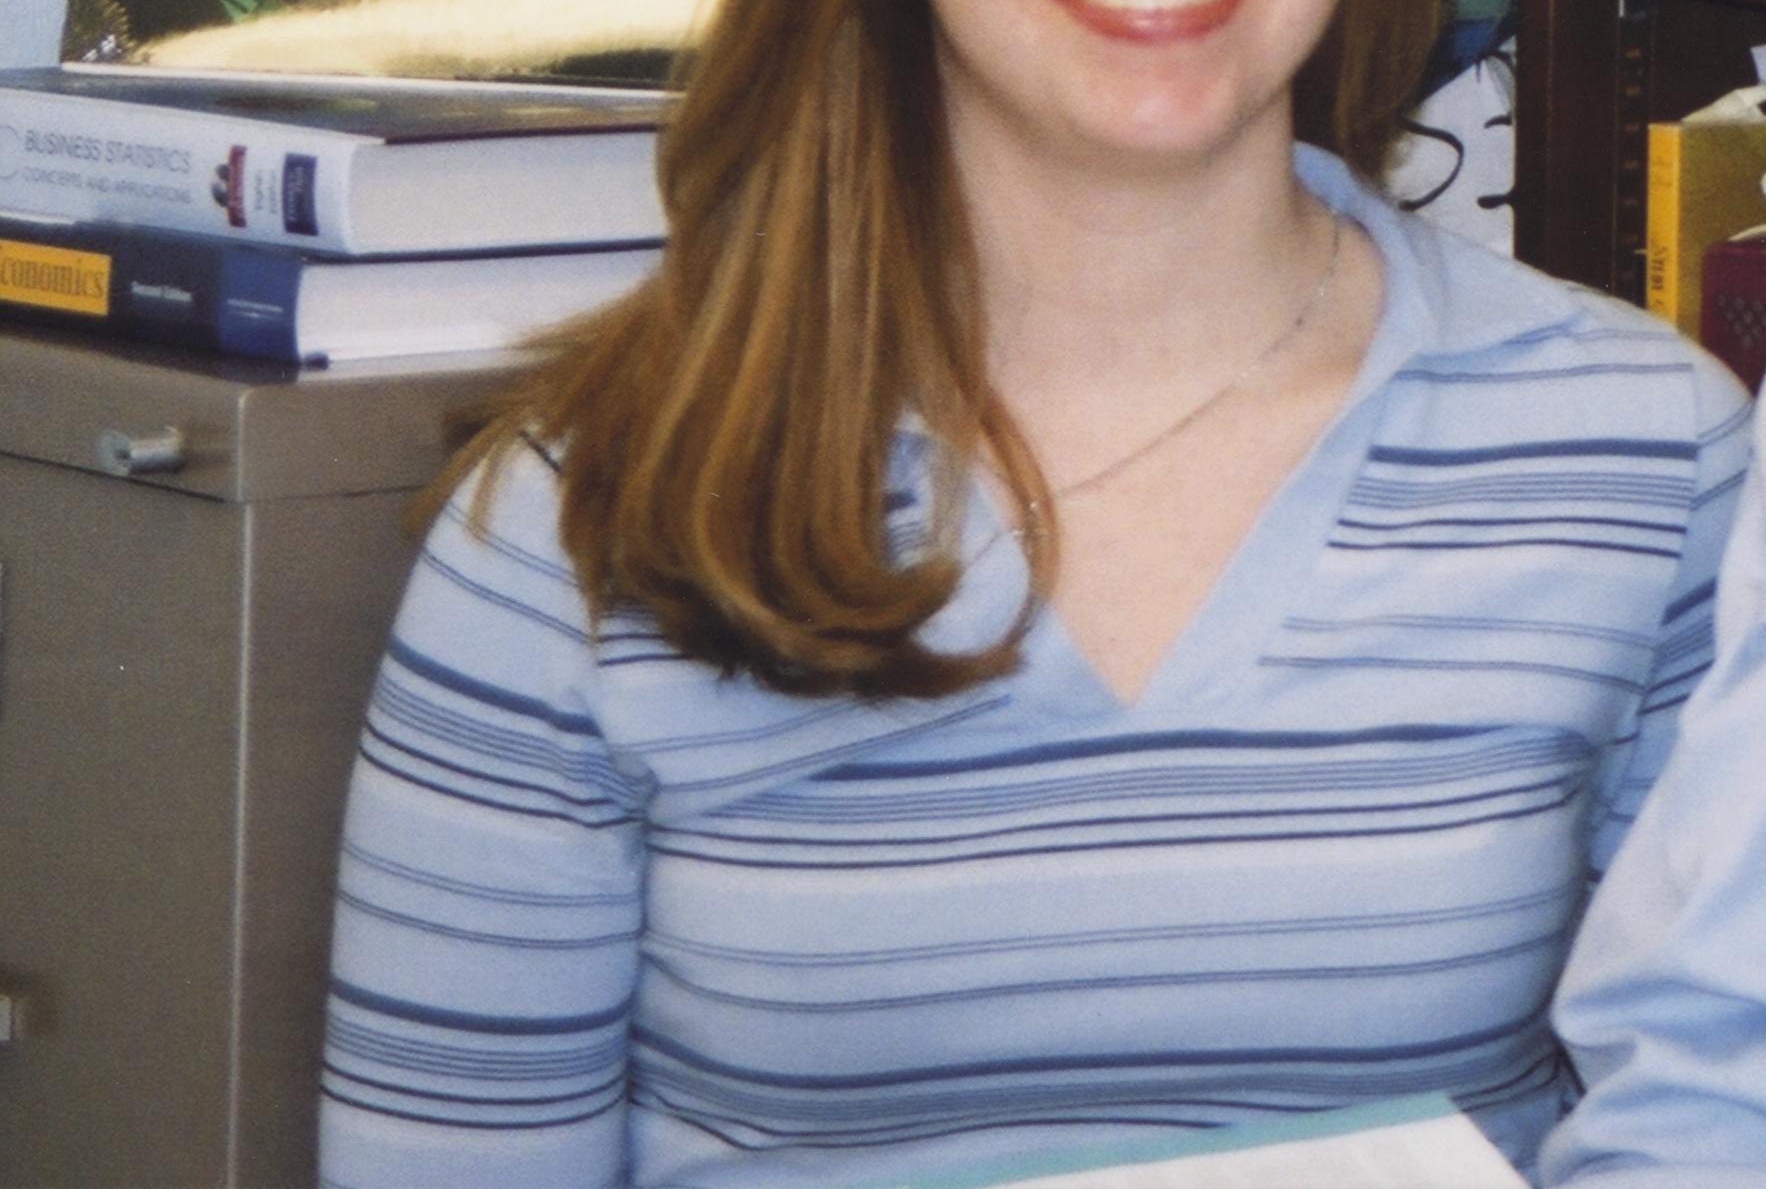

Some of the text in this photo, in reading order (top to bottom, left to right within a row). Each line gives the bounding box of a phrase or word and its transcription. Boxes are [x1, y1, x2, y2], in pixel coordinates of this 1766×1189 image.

[24, 129, 191, 174] BUSINESS STATISTICS
[22, 165, 191, 205] CONCEPTS AND APPLICATIONS
[0, 256, 106, 299] conomics
